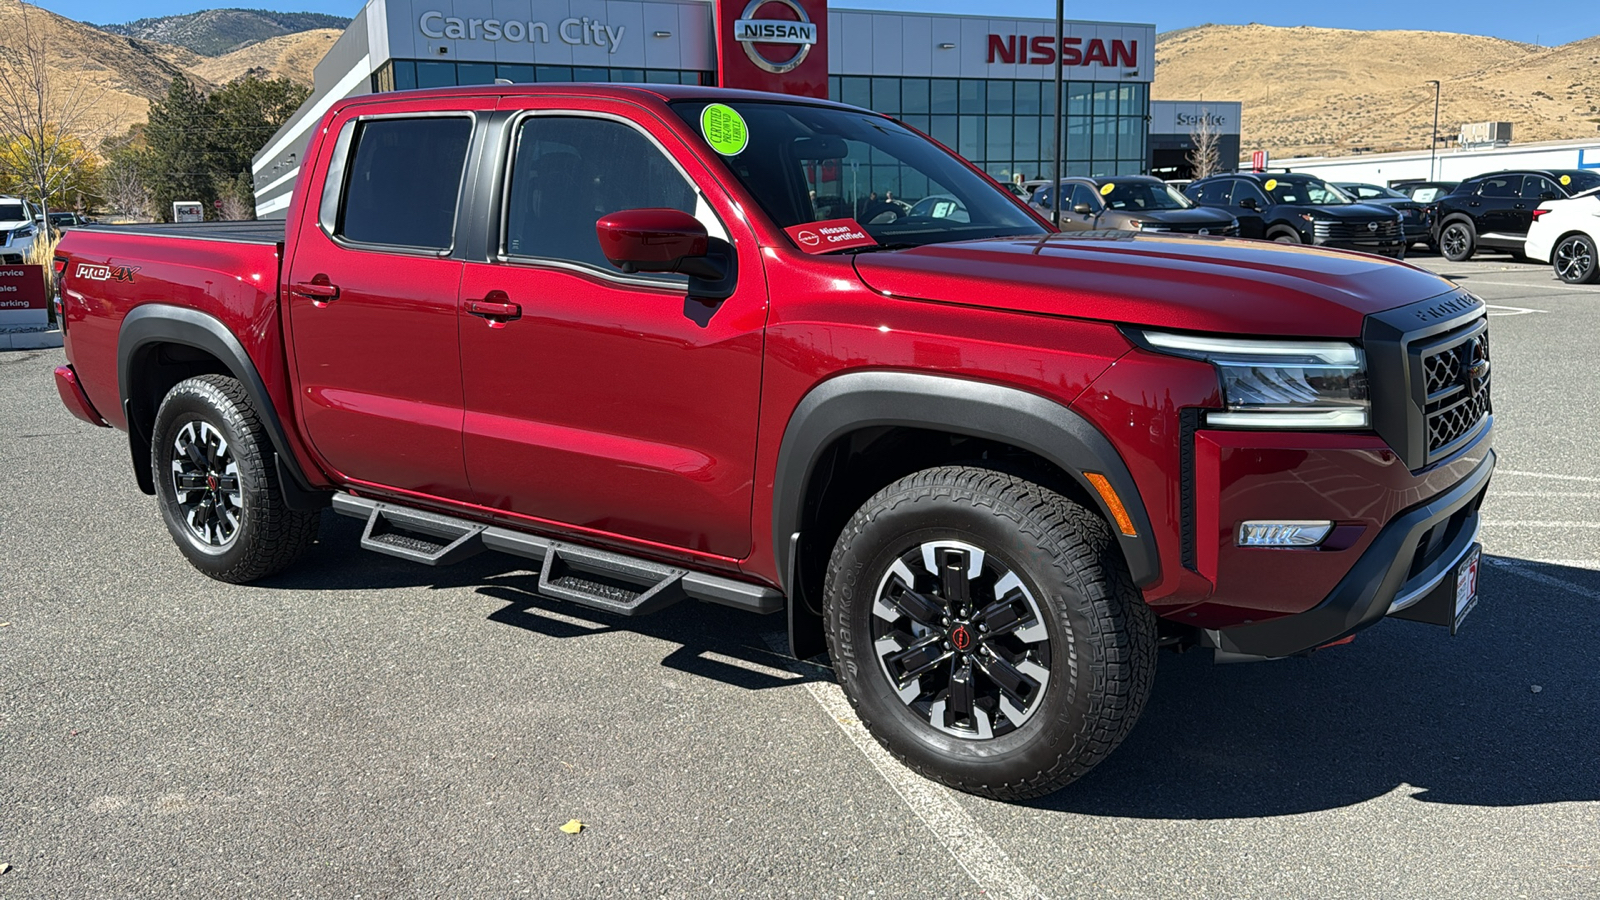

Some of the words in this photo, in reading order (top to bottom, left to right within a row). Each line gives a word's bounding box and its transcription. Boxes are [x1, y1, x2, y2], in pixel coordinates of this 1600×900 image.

[420, 11, 550, 43] Carson
[559, 17, 626, 54] City
[744, 24, 811, 40] NISSAN
[987, 34, 1138, 68] NISSAN
[710, 107, 722, 144] CERTIFIED
[1177, 112, 1225, 126] Service
[178, 207, 200, 215] FedEx
[819, 226, 851, 235] Nissan
[827, 231, 866, 243] Certified
[0, 269, 24, 277] ervice
[0, 300, 30, 308] arking
